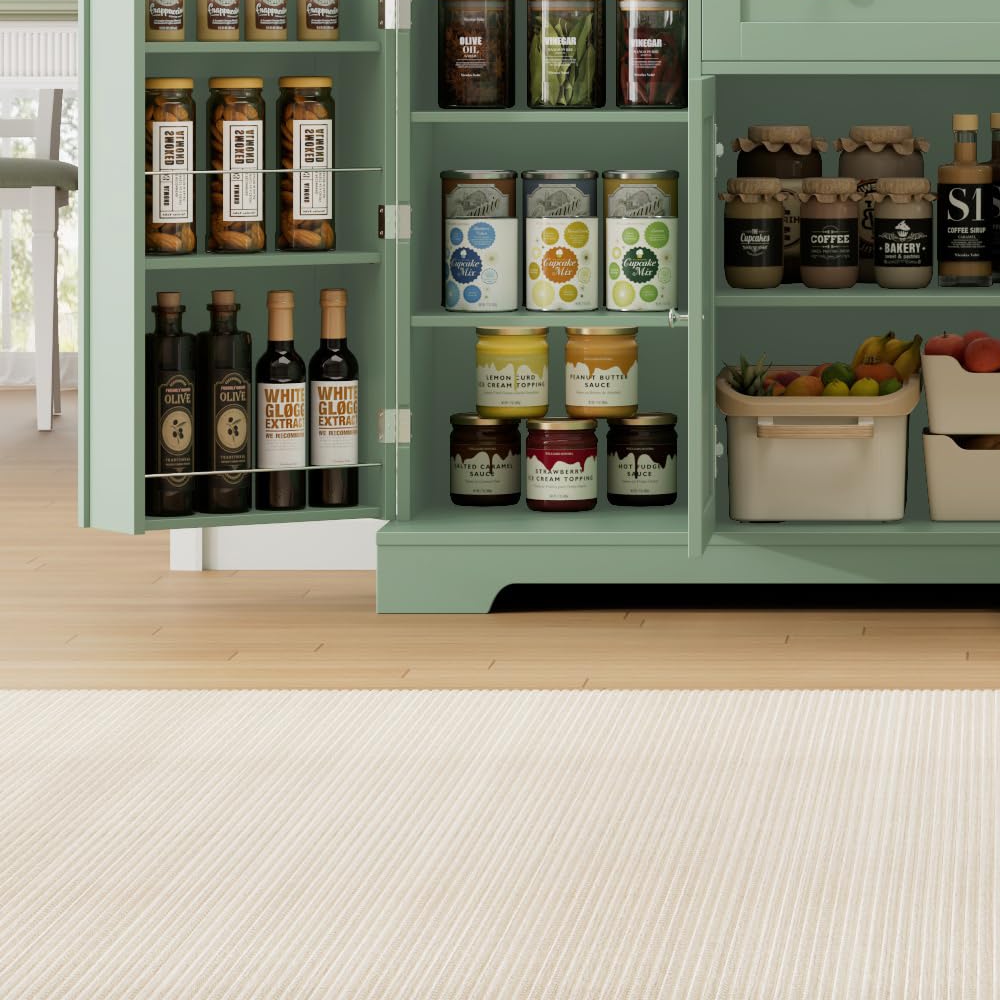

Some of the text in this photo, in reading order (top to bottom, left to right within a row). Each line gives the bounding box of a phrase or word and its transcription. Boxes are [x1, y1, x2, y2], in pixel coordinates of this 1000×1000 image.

[460, 36, 483, 46] OLIVE
[544, 36, 576, 45] VINEGAR
[631, 39, 662, 47] VINEGAR
[463, 46, 479, 54] OIL
[947, 187, 984, 222] S1
[740, 232, 770, 244] Cupcakes
[810, 235, 850, 244] COFFEE
[884, 242, 921, 253] BAKERY
[451, 258, 480, 270] Cupcake
[543, 257, 577, 270] Cupcake
[623, 257, 657, 270] Cupcake
[460, 267, 477, 277] Mix
[553, 267, 573, 277] Mix
[632, 267, 654, 277] Mix
[164, 392, 191, 404] OLIVE
[220, 390, 246, 402] OLIVE
[264, 388, 305, 403] WHITE
[317, 386, 358, 401] WHITE
